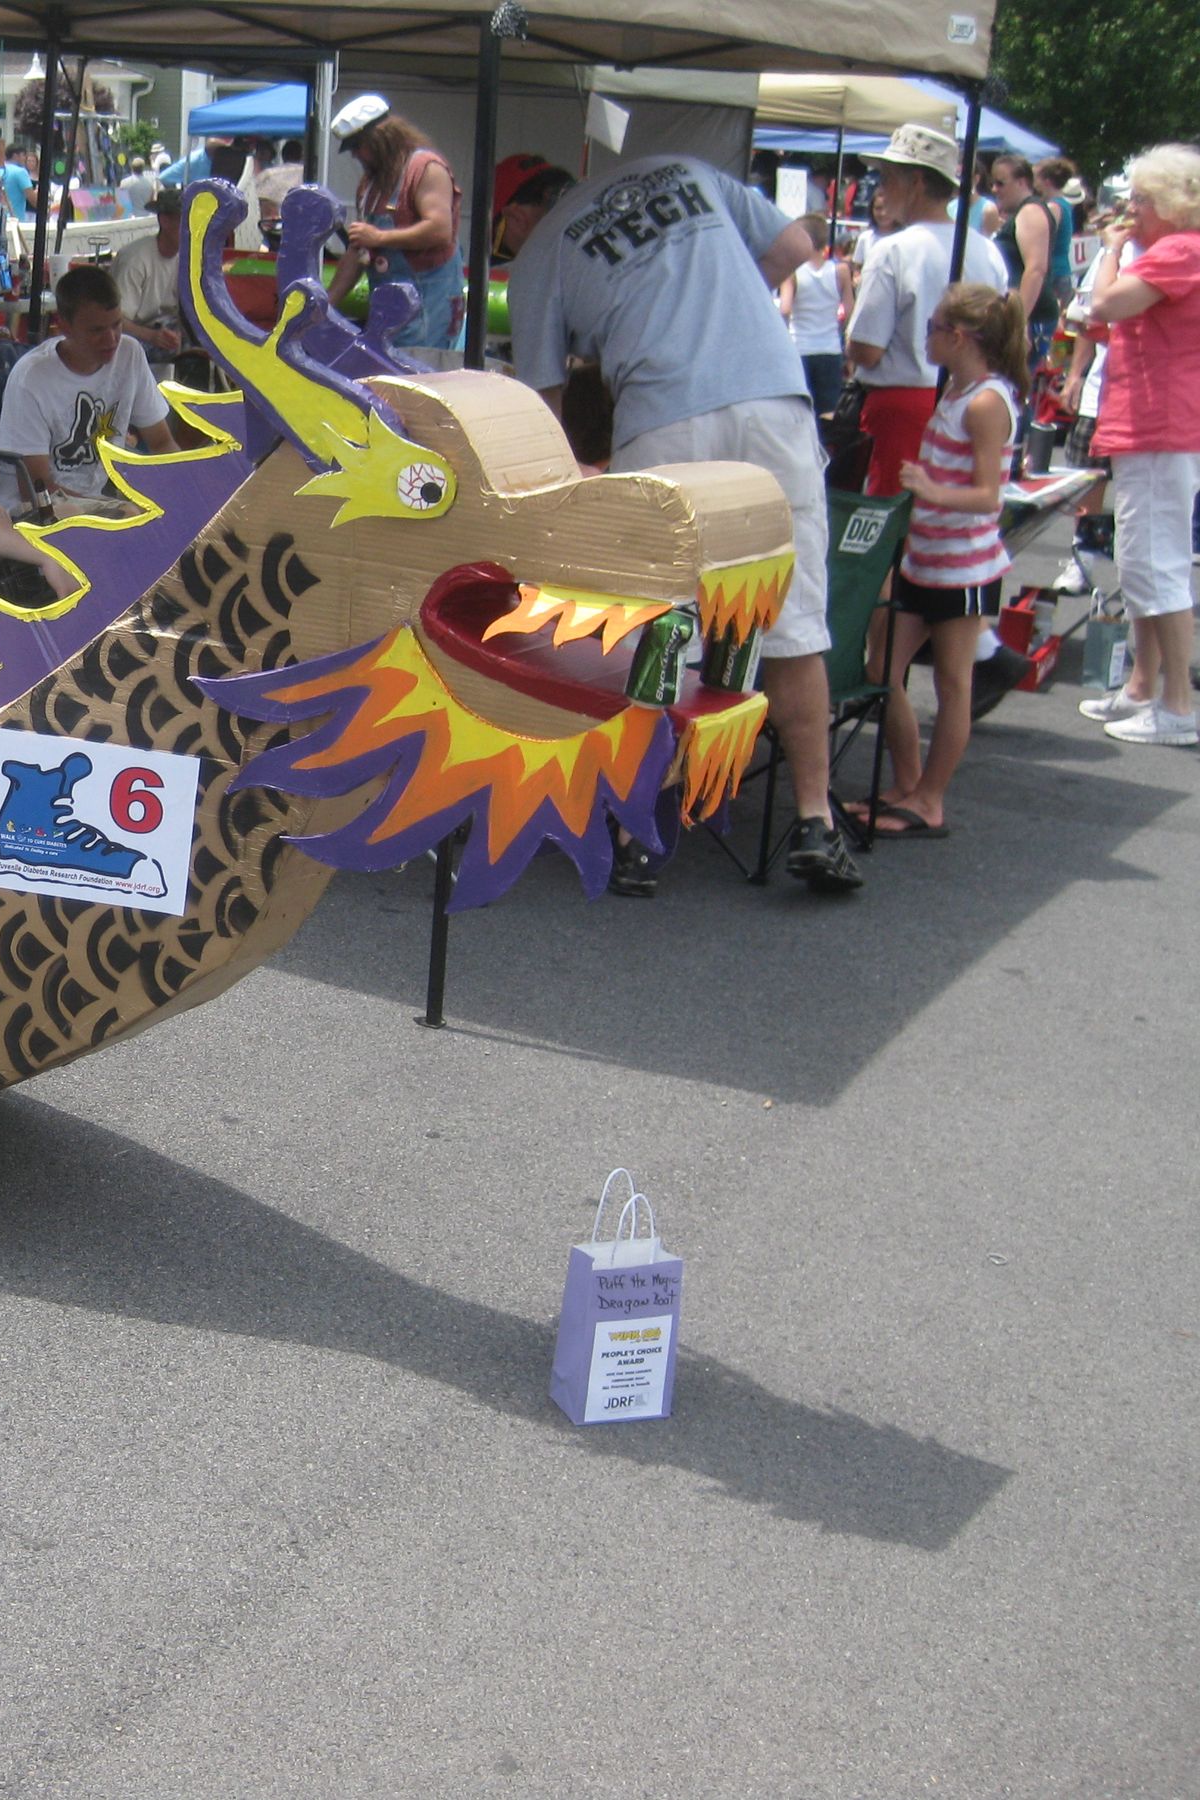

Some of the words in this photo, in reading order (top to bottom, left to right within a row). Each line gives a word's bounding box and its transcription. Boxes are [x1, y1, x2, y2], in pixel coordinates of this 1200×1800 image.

[582, 182, 714, 266] TECH
[109, 767, 164, 834] 6
[0, 833, 16, 841] WALK
[23, 865, 49, 876] Diabetes
[50, 869, 78, 880] Research
[79, 873, 113, 886] Foundation
[115, 880, 161, 894] www.jdrf.org
[596, 1274, 625, 1290] Puff
[630, 1273, 646, 1288] the
[601, 1349, 635, 1359] PEOPLE'S
[636, 1346, 663, 1355] CHOICE
[617, 1358, 645, 1366] AWARD
[603, 1395, 635, 1410] JDRF
